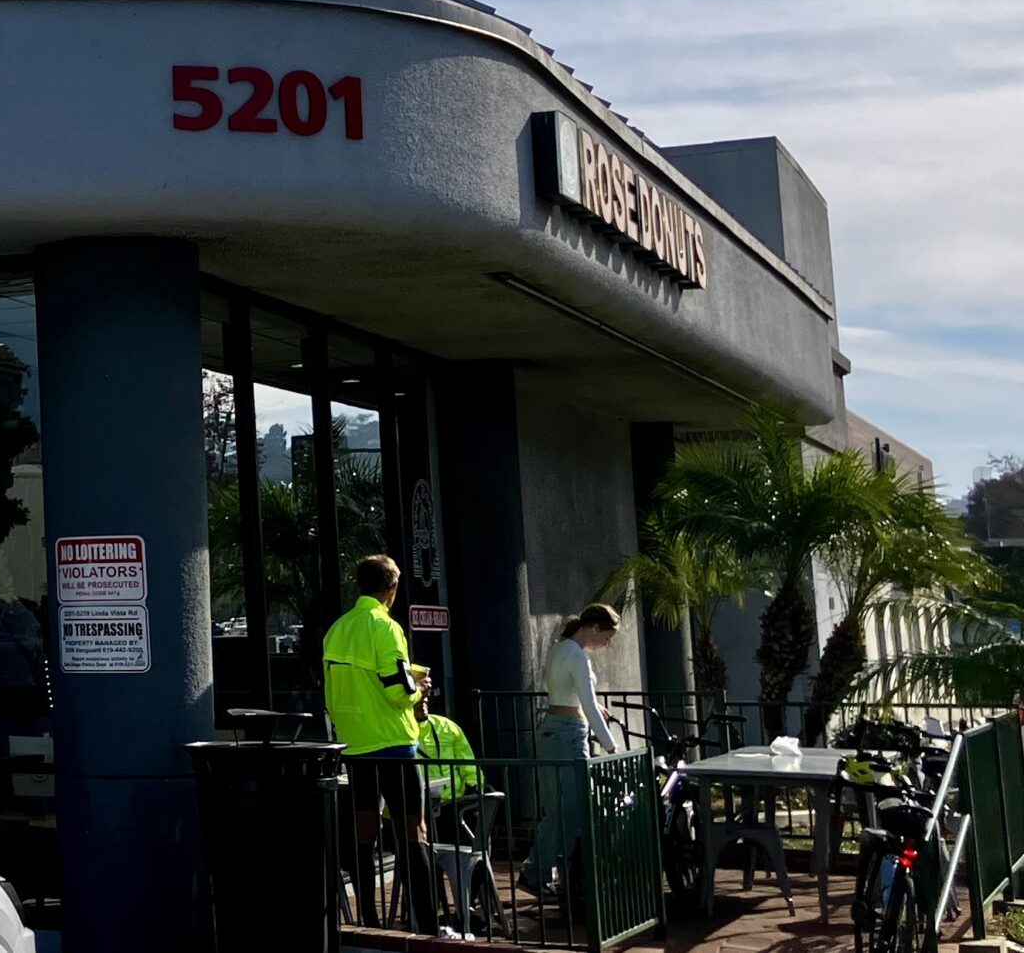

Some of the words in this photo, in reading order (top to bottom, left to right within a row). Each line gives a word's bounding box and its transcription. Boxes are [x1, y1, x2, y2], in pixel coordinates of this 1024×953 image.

[172, 66, 364, 140] 5201
[579, 128, 640, 242] ROSE
[637, 174, 707, 289] DONUTS
[61, 545, 74, 561] NO
[75, 543, 137, 561] LOITERING
[62, 566, 138, 579] VIOLATORS
[87, 580, 139, 589] PROSECUTED
[63, 623, 73, 637] NO
[74, 622, 143, 637] TRESPASSING
